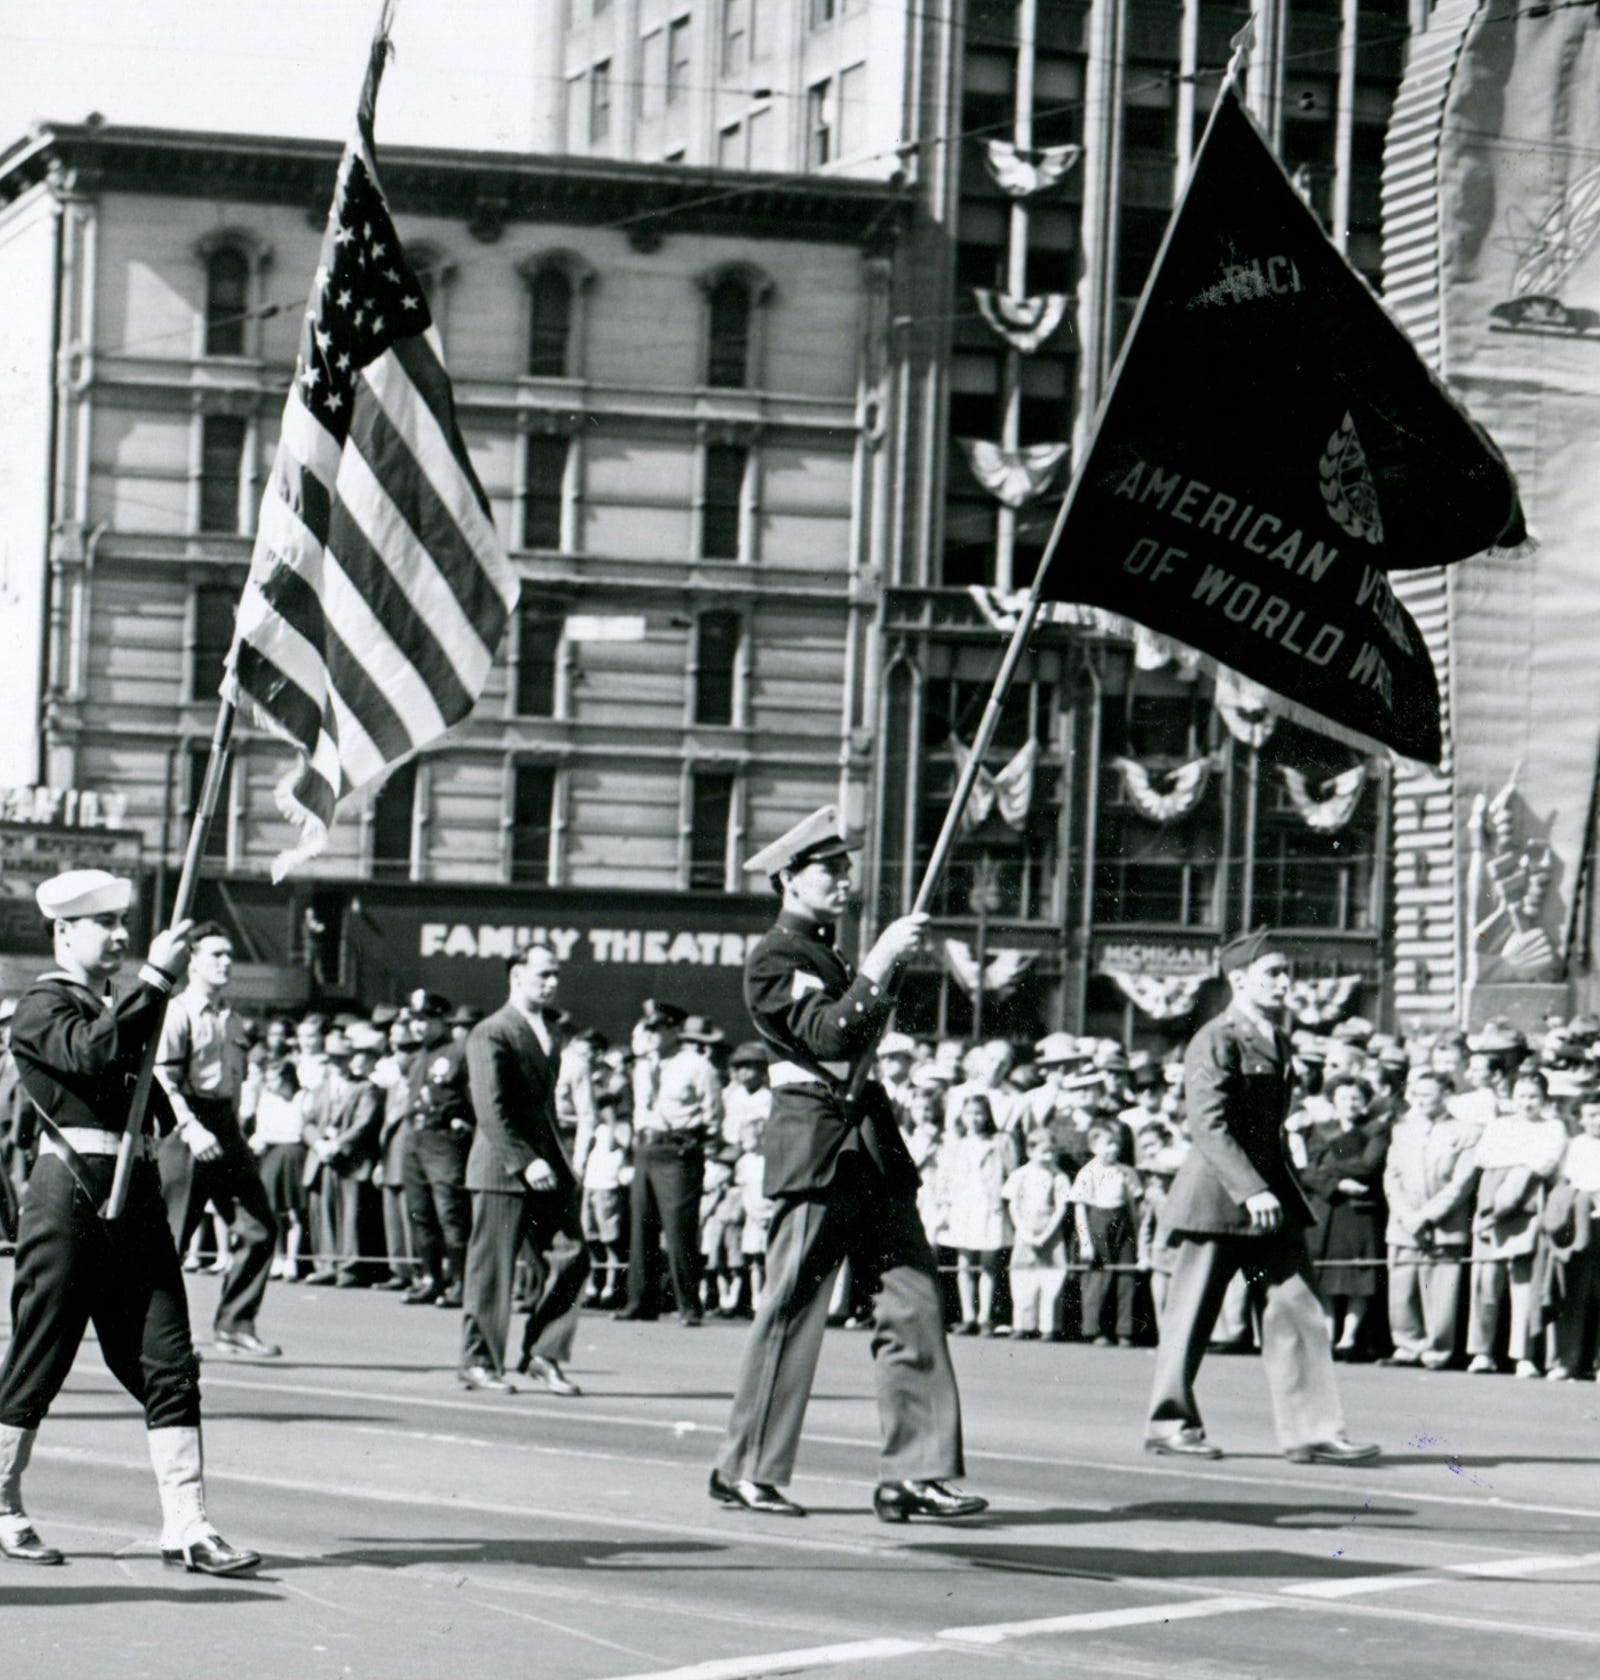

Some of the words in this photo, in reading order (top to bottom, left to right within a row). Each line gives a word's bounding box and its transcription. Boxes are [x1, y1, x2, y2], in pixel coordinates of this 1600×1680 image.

[1114, 460, 1339, 583] AMERICAN
[1122, 537, 1189, 582] OF
[1191, 563, 1346, 667] WORLD
[420, 922, 580, 962] FAMILY
[1103, 944, 1210, 967] MICHIGAN
